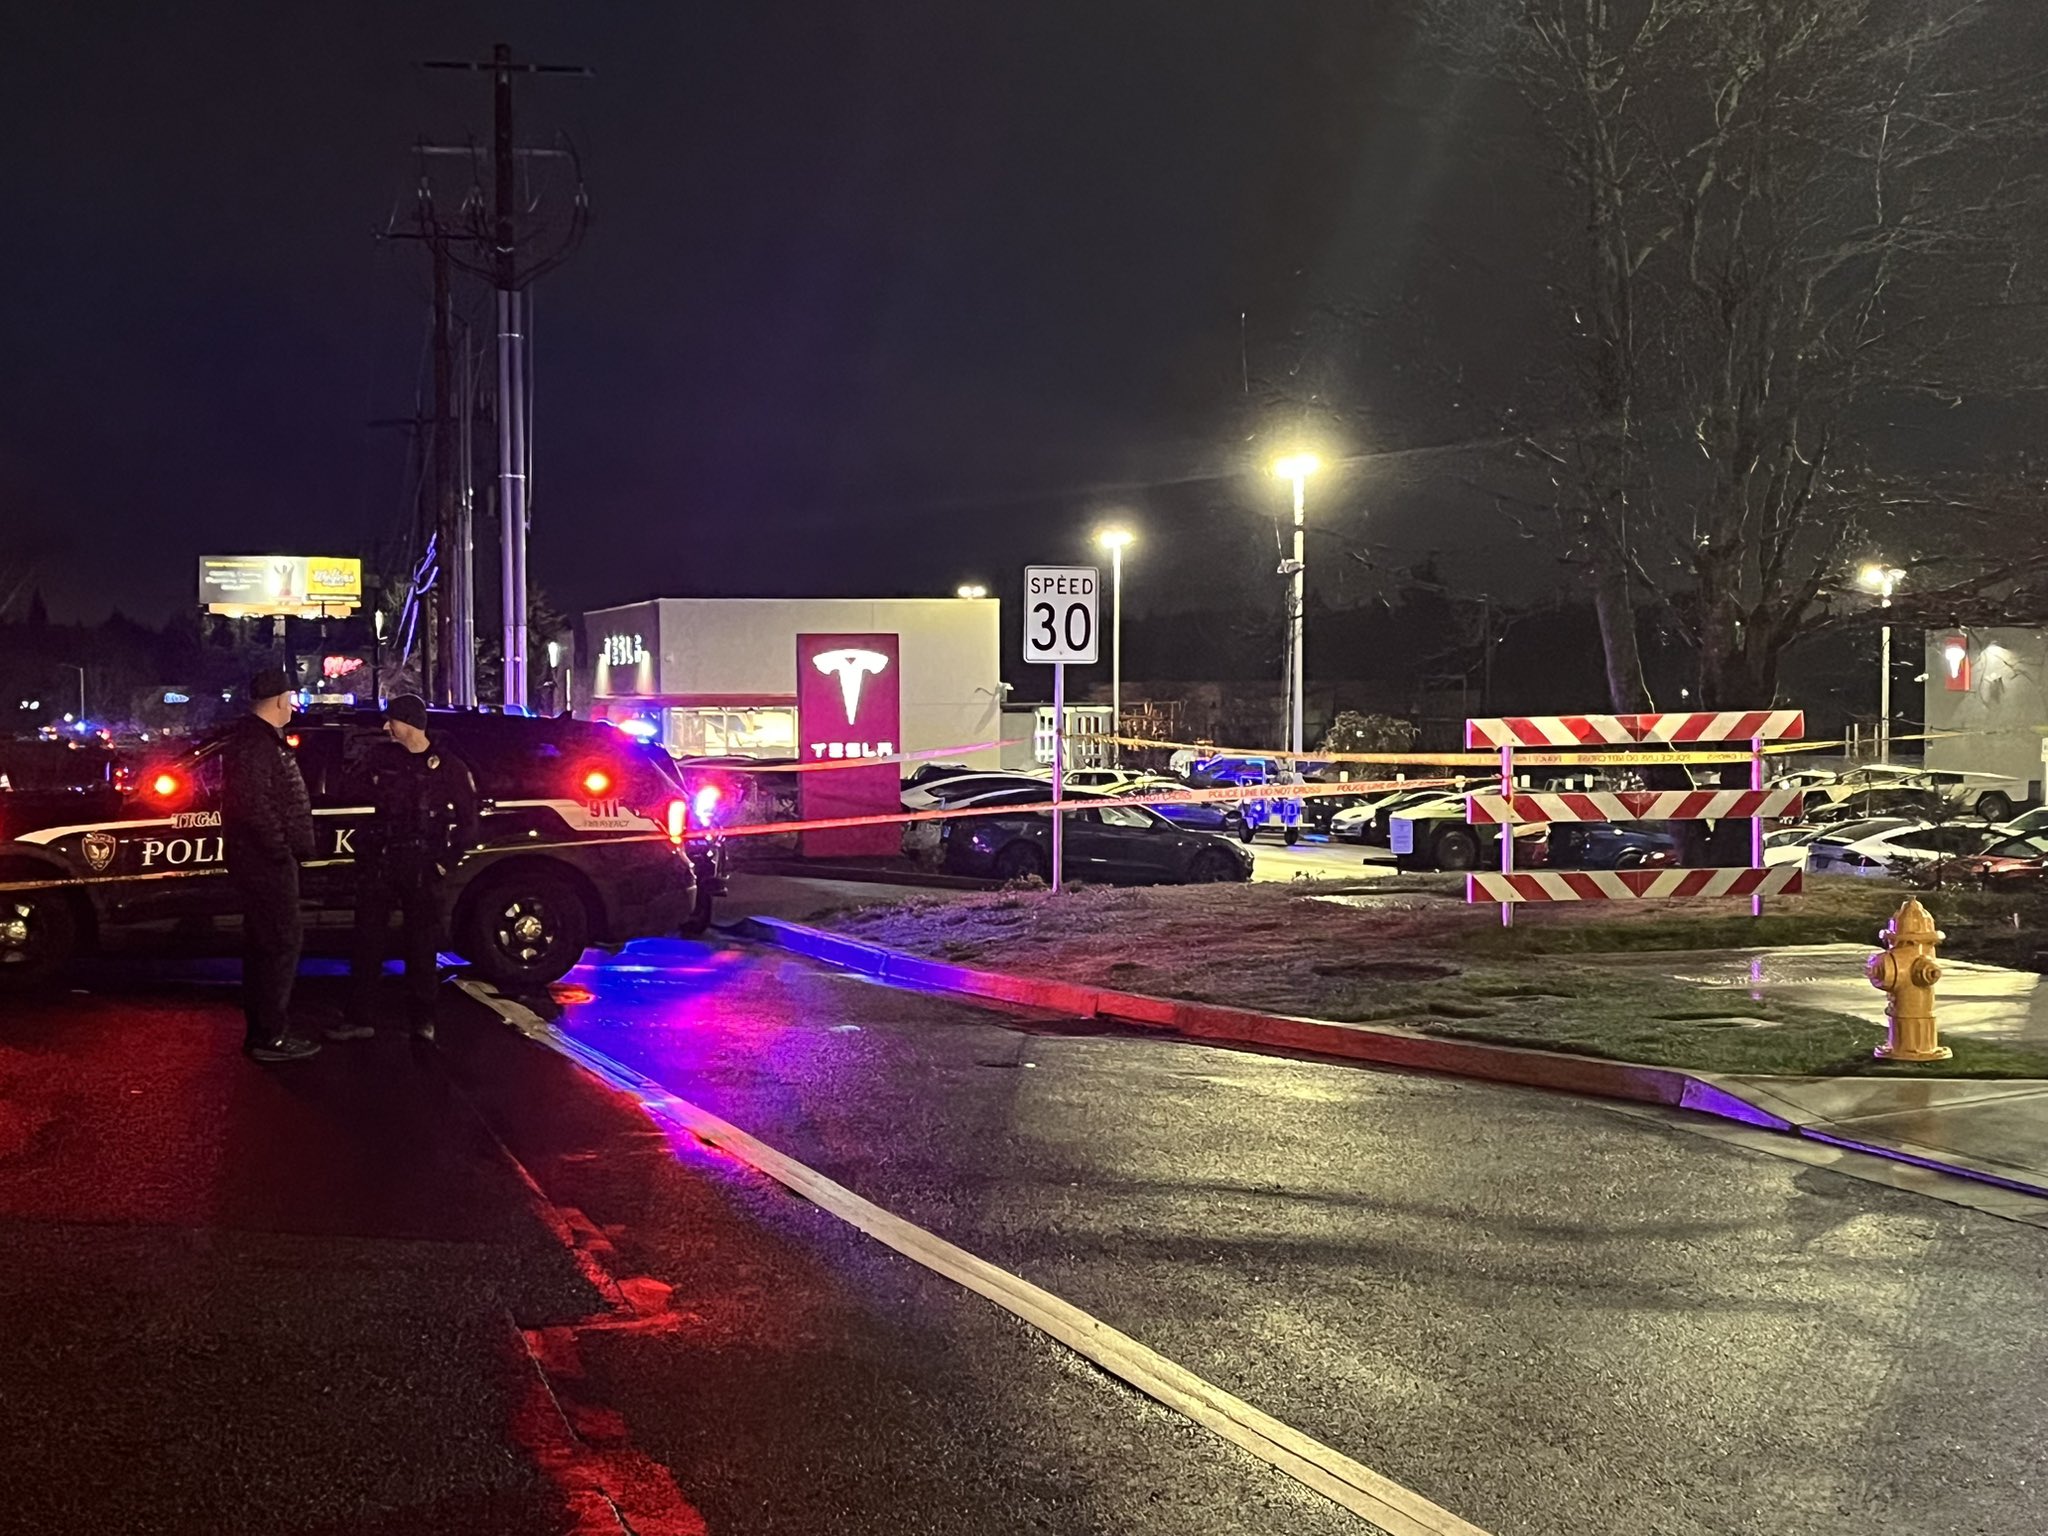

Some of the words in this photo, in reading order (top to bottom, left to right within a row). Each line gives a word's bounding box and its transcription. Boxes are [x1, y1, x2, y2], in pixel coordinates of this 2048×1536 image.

[1030, 577, 1093, 595] SPEED
[1031, 602, 1091, 651] 30
[810, 742, 893, 758] TESLA
[1208, 788, 1238, 799] POLICE
[1241, 788, 1258, 798] LINE
[1260, 787, 1273, 796] DO
[1275, 786, 1291, 796] NOT
[1293, 785, 1321, 795] CROSS
[590, 798, 619, 817] 911
